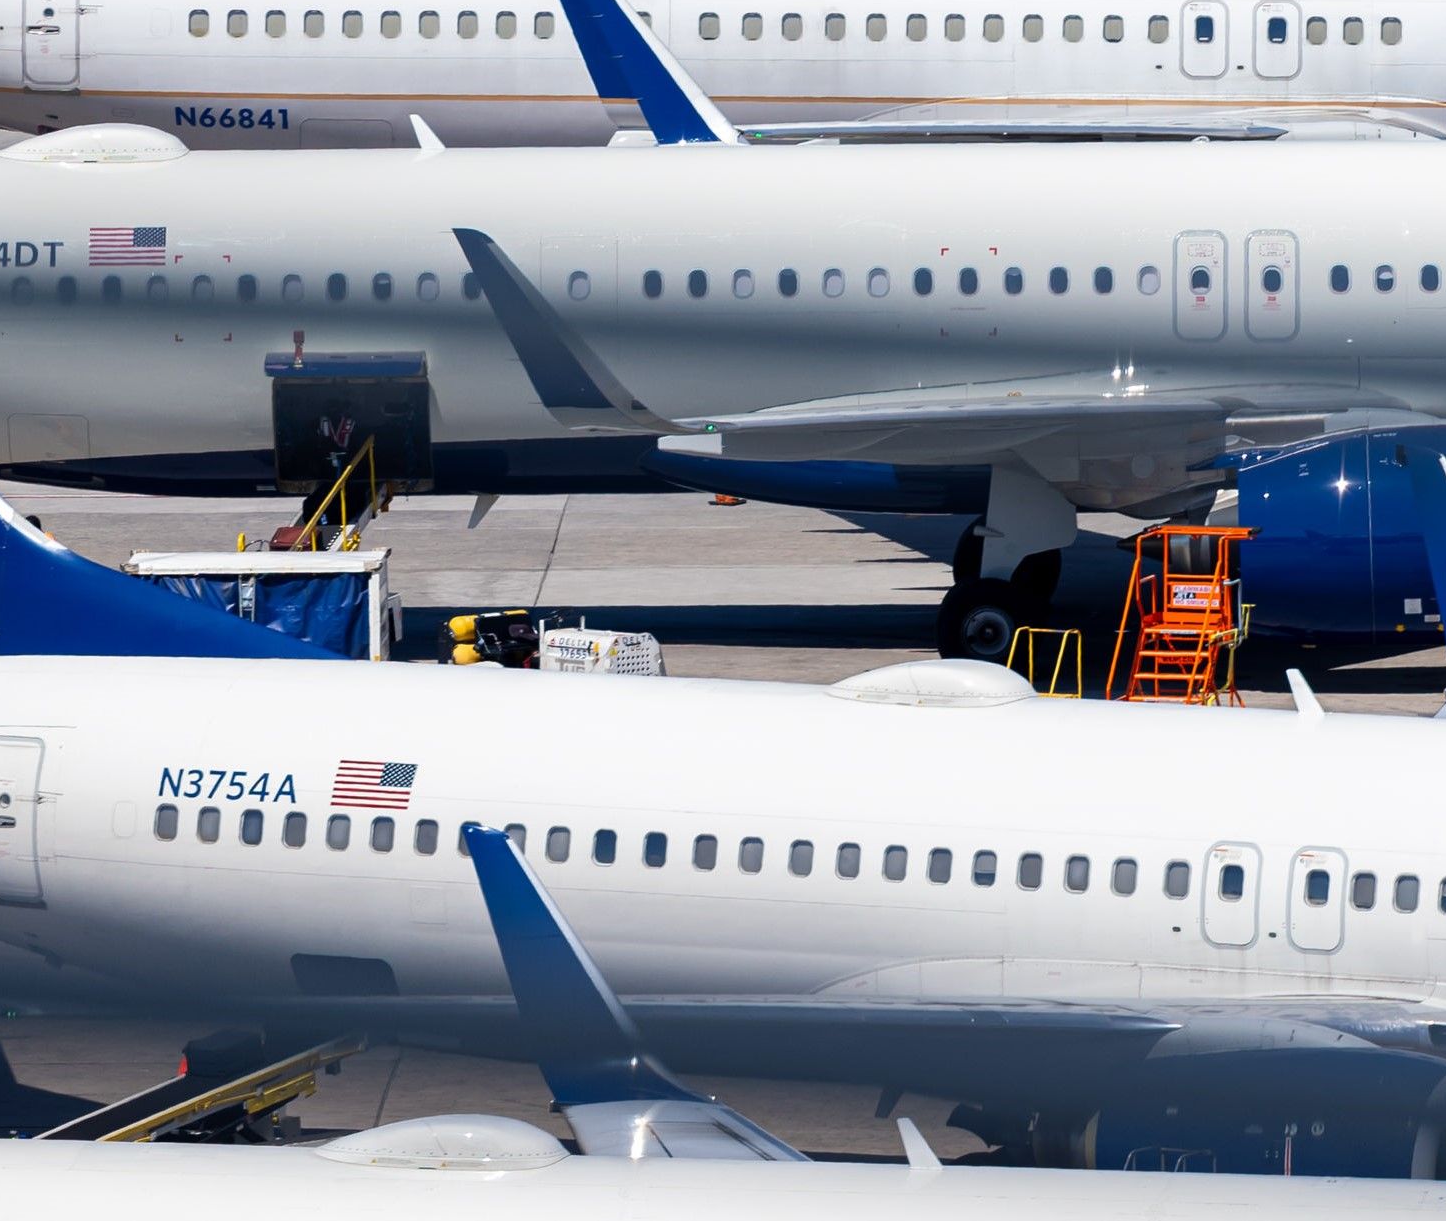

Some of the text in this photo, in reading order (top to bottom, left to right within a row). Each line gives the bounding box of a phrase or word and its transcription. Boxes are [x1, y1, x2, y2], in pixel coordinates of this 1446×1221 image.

[175, 107, 290, 130] N66841
[558, 637, 587, 647] DELTA
[622, 634, 653, 644] DELTA
[158, 767, 297, 804] N3754A
